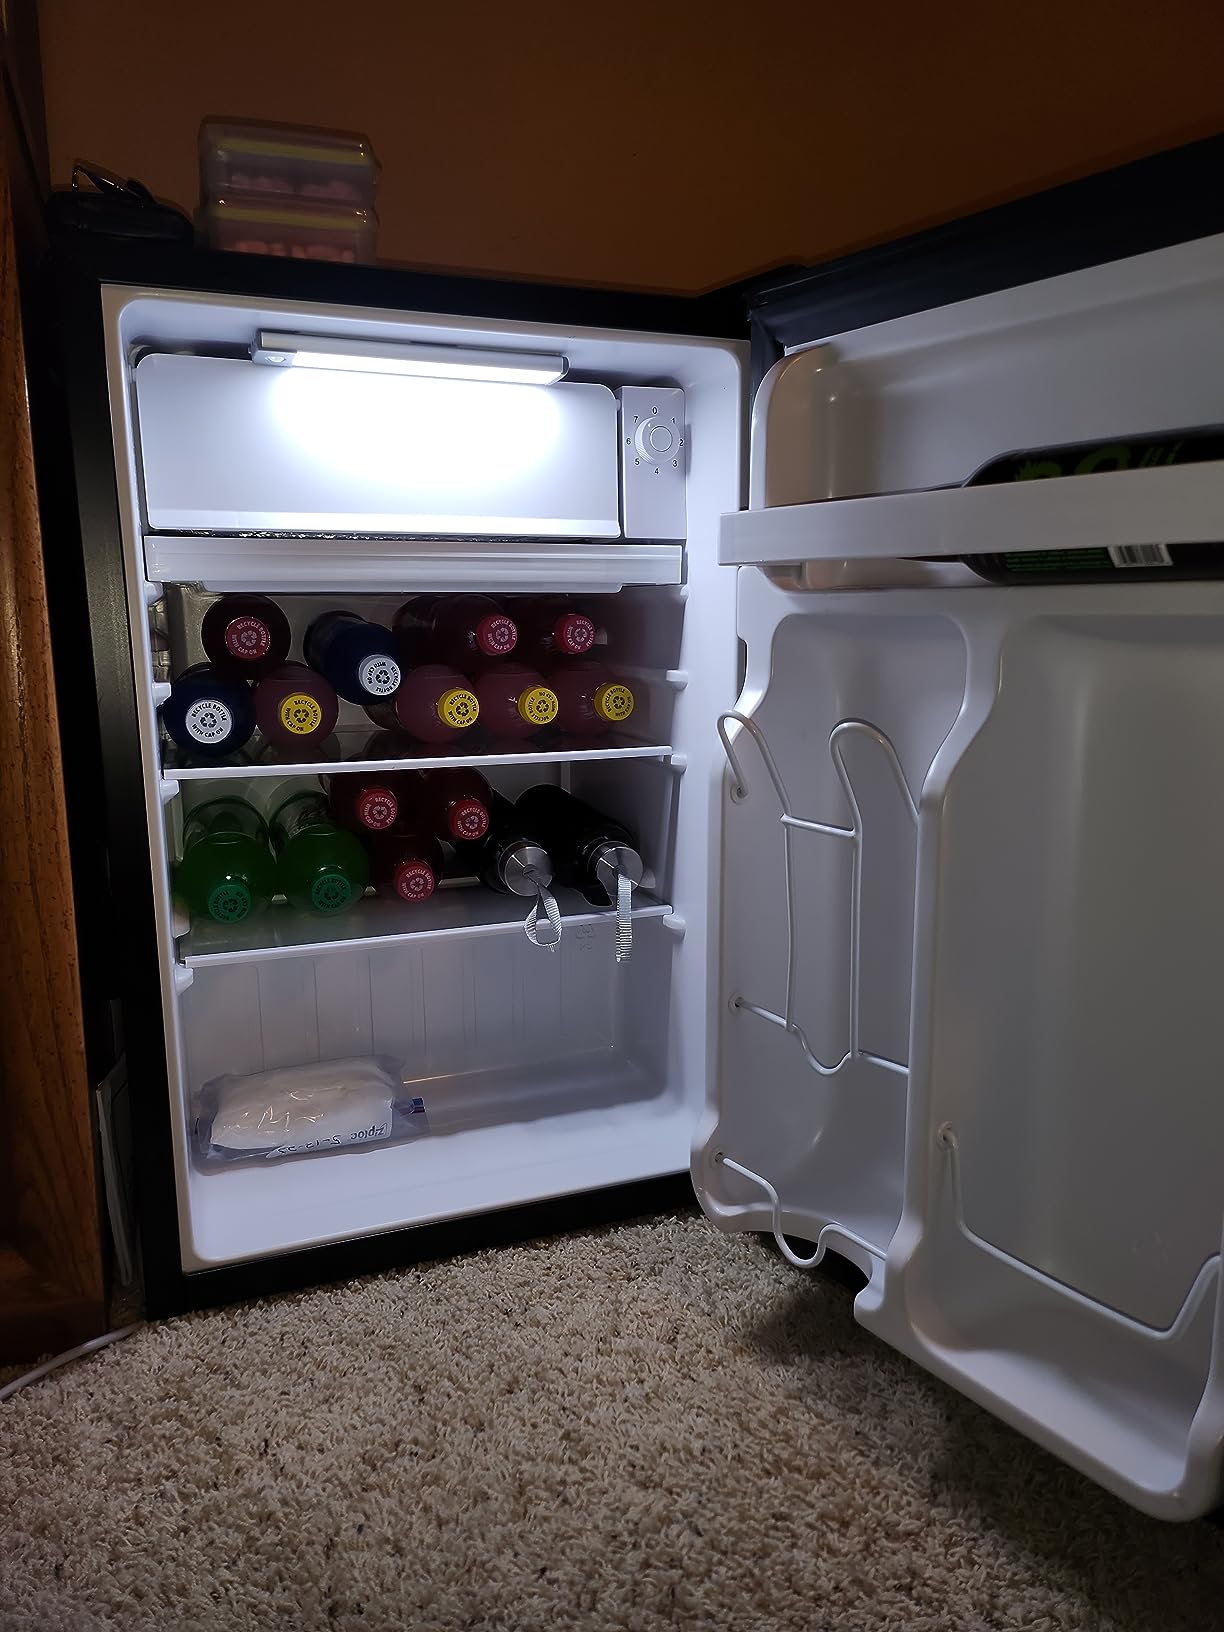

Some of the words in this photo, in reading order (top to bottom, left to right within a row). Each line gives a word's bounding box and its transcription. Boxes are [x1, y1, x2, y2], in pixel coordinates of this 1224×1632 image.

[652, 406, 658, 415] 0
[633, 415, 639, 424] 7
[626, 437, 631, 445] 6
[679, 438, 684, 447] 2
[635, 458, 640, 466] 5
[672, 459, 678, 467] 3
[654, 467, 659, 475] 4
[237, 622, 260, 630] RECYCLE
[450, 694, 466, 705] RECYCLE
[467, 696, 476, 711] BOTTLE
[191, 703, 212, 718] RECYCLE
[212, 703, 228, 721] BOTTLE
[294, 700, 315, 709] RECYCLE
[309, 710, 318, 727] BOTTLE
[374, 797, 394, 808] RECYCLE
[386, 808, 396, 824] BOTTLE
[350, 1125, 385, 1140] Ziploc
